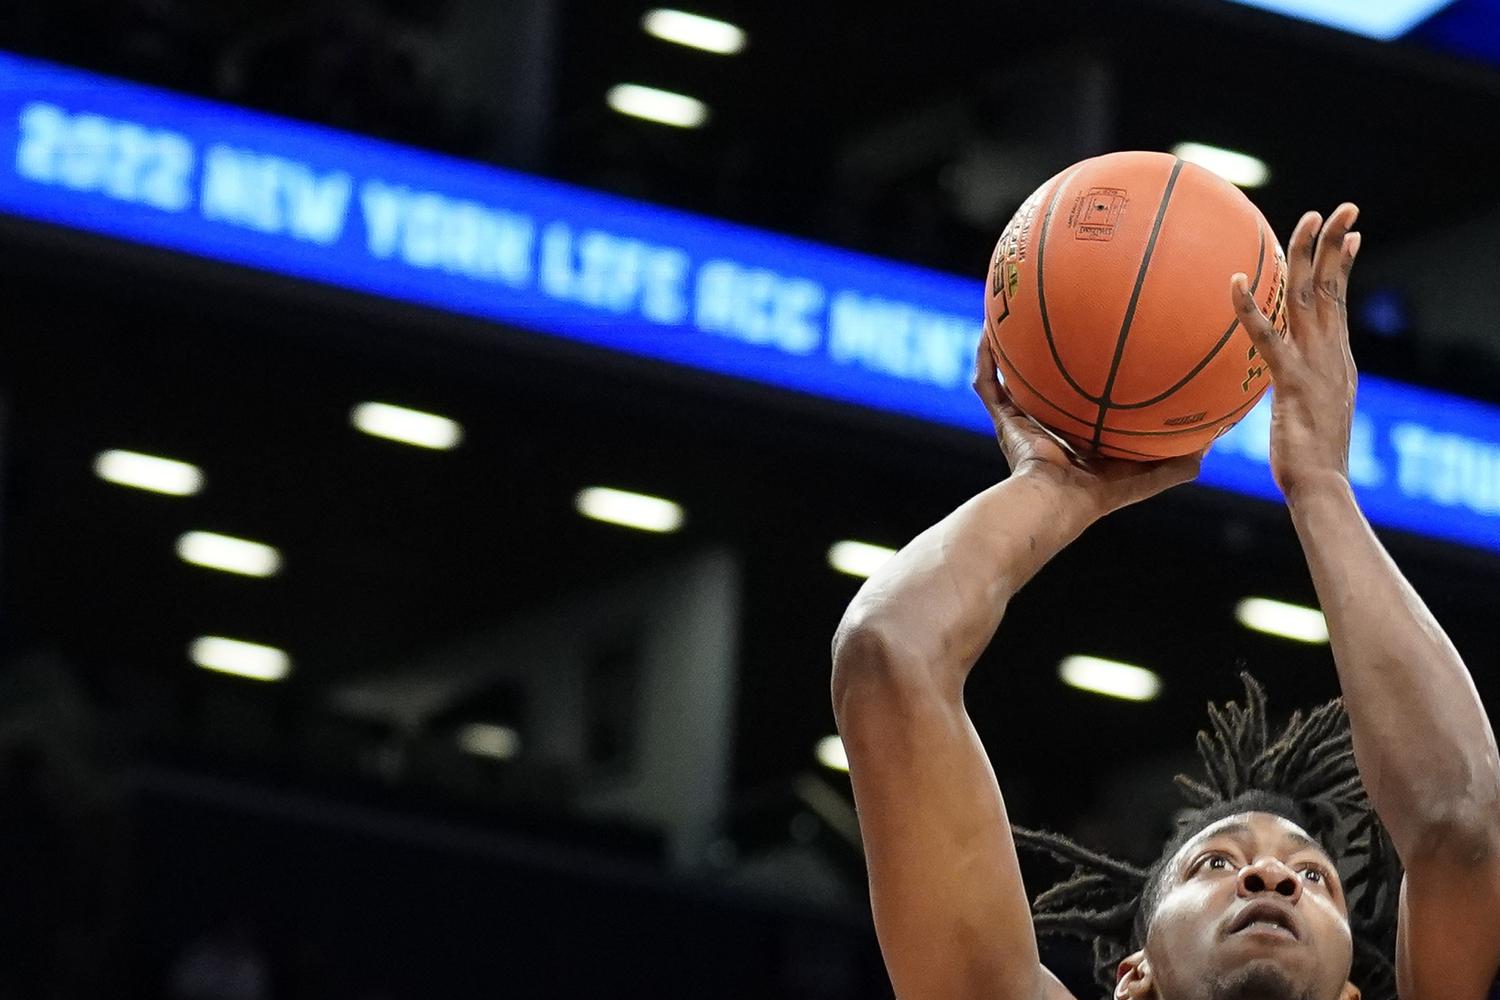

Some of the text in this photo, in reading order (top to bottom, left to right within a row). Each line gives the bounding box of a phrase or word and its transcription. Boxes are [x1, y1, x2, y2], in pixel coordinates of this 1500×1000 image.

[17, 102, 194, 213] 2022
[203, 142, 351, 247] NEW
[360, 179, 534, 291] YORK
[540, 220, 689, 326] LIFE
[695, 259, 824, 356] ACC
